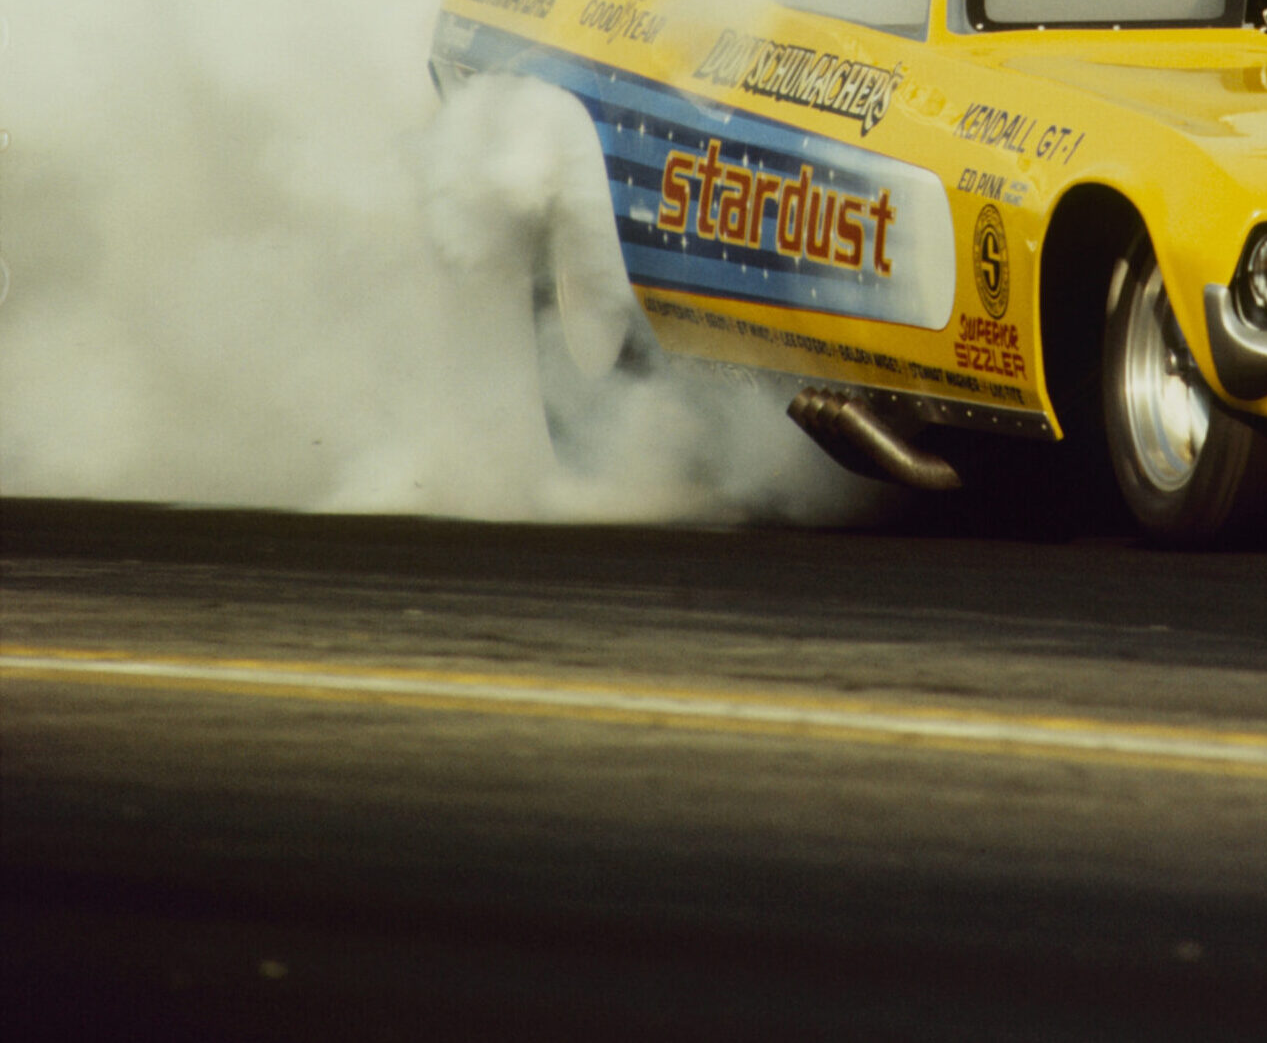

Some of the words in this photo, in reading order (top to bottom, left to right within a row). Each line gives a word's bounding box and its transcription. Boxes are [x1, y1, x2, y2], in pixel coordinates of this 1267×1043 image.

[953, 102, 1037, 154] KENDALL
[957, 168, 979, 192] ED
[977, 170, 1007, 203] PINK
[657, 138, 897, 278] stardust
[958, 312, 1020, 352] SUPERIOR
[953, 341, 1028, 381] SIZZLER
